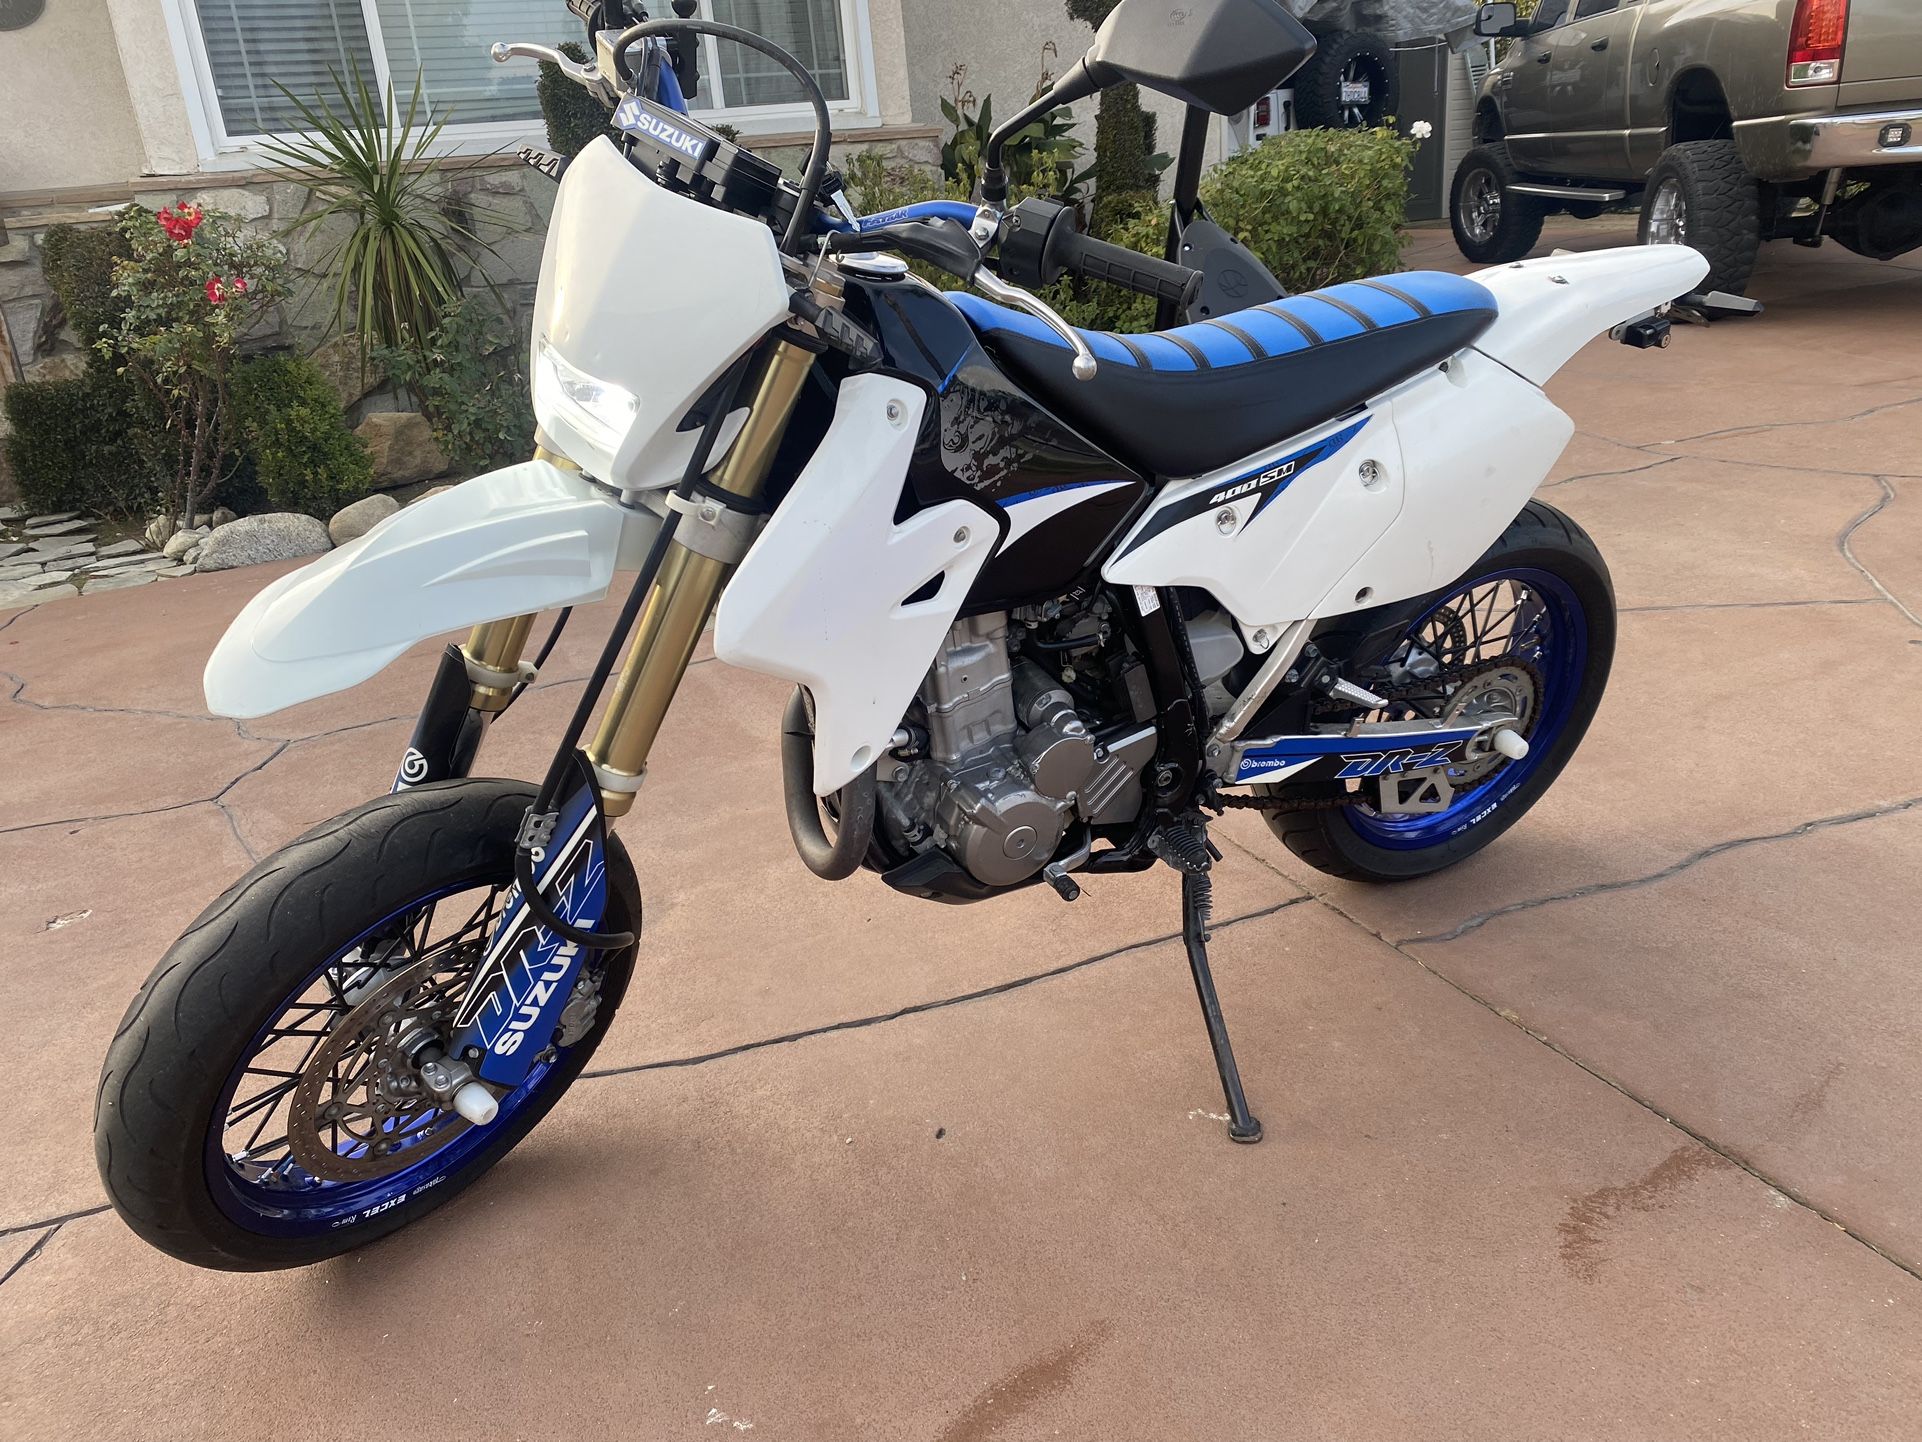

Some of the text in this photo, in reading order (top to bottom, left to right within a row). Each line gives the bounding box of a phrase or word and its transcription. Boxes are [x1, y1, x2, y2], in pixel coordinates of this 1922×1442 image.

[637, 113, 703, 160] SUZUKI
[1209, 460, 1296, 505] 400 SM
[1251, 759, 1286, 768] brembo
[1334, 739, 1464, 779] DR-Z
[1469, 802, 1498, 825] EXCEL
[362, 1194, 407, 1218] EXCEL
